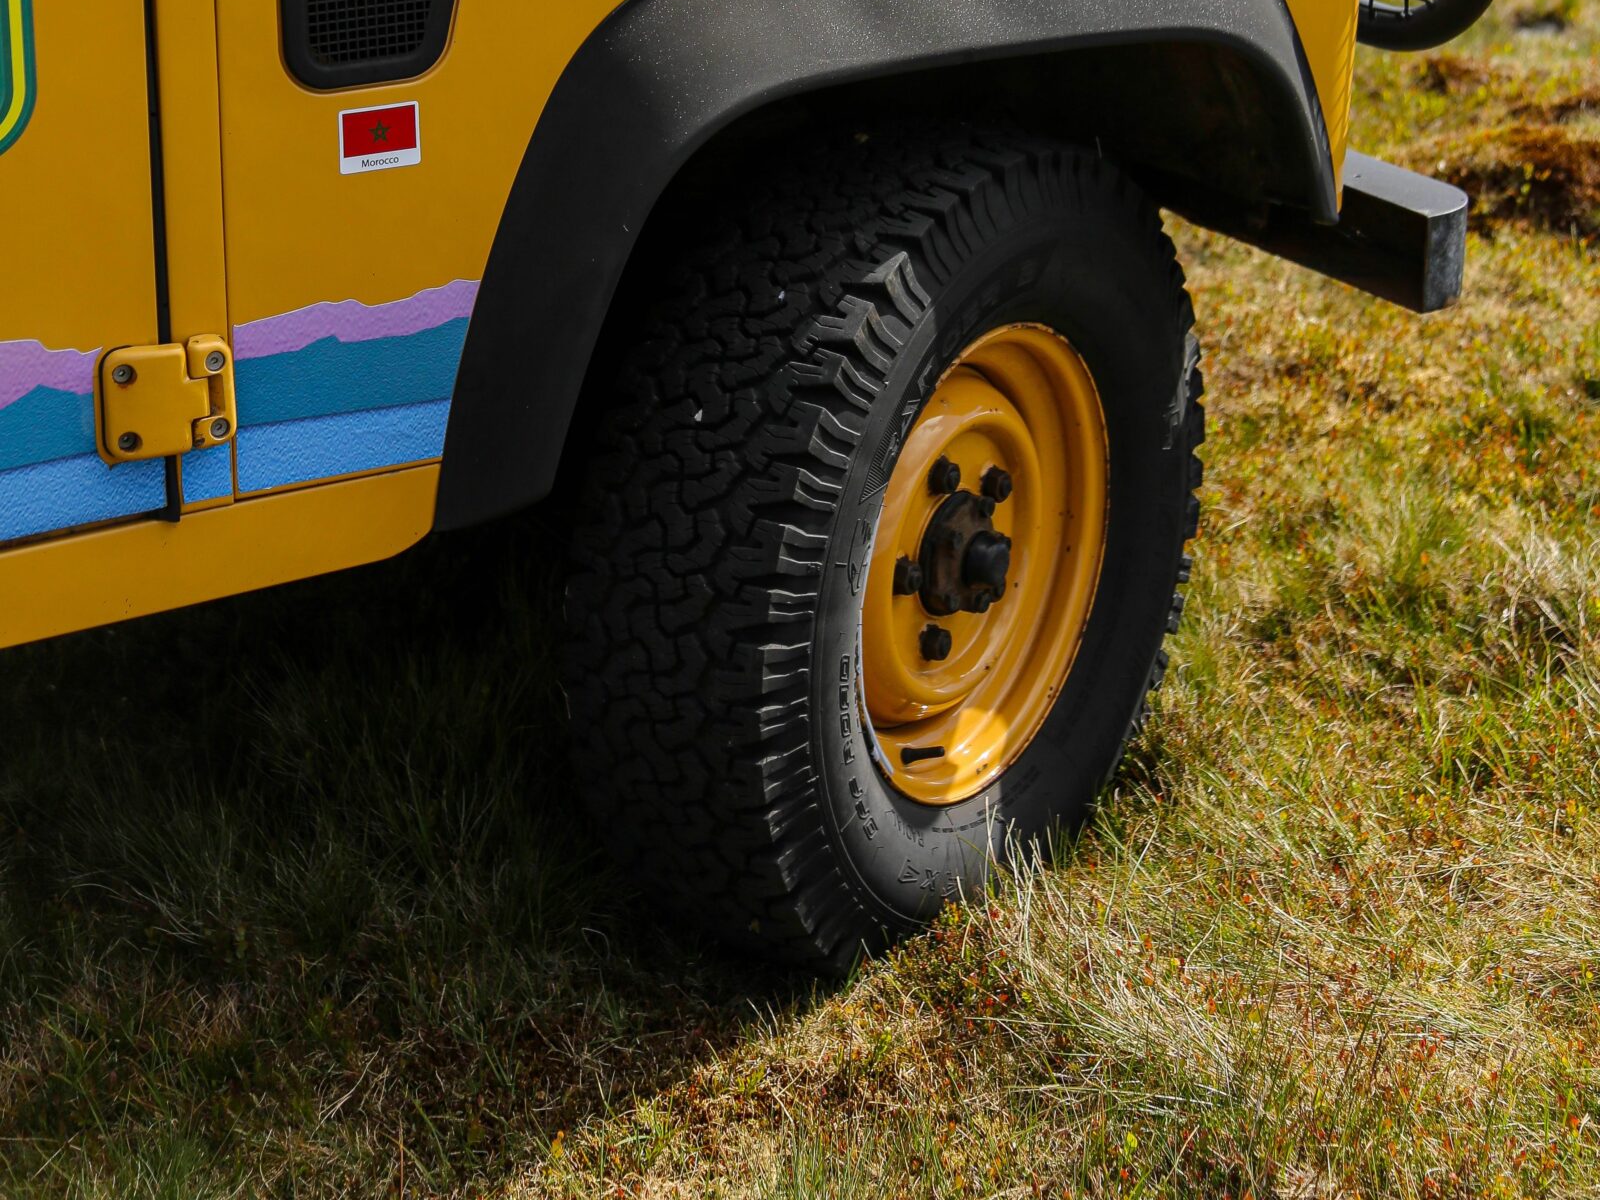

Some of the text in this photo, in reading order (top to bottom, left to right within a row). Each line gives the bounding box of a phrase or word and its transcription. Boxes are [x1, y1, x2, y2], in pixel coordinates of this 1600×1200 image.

[361, 156, 399, 168] Morocco
[838, 654, 856, 766] ROAD
[848, 776, 879, 841] OFF
